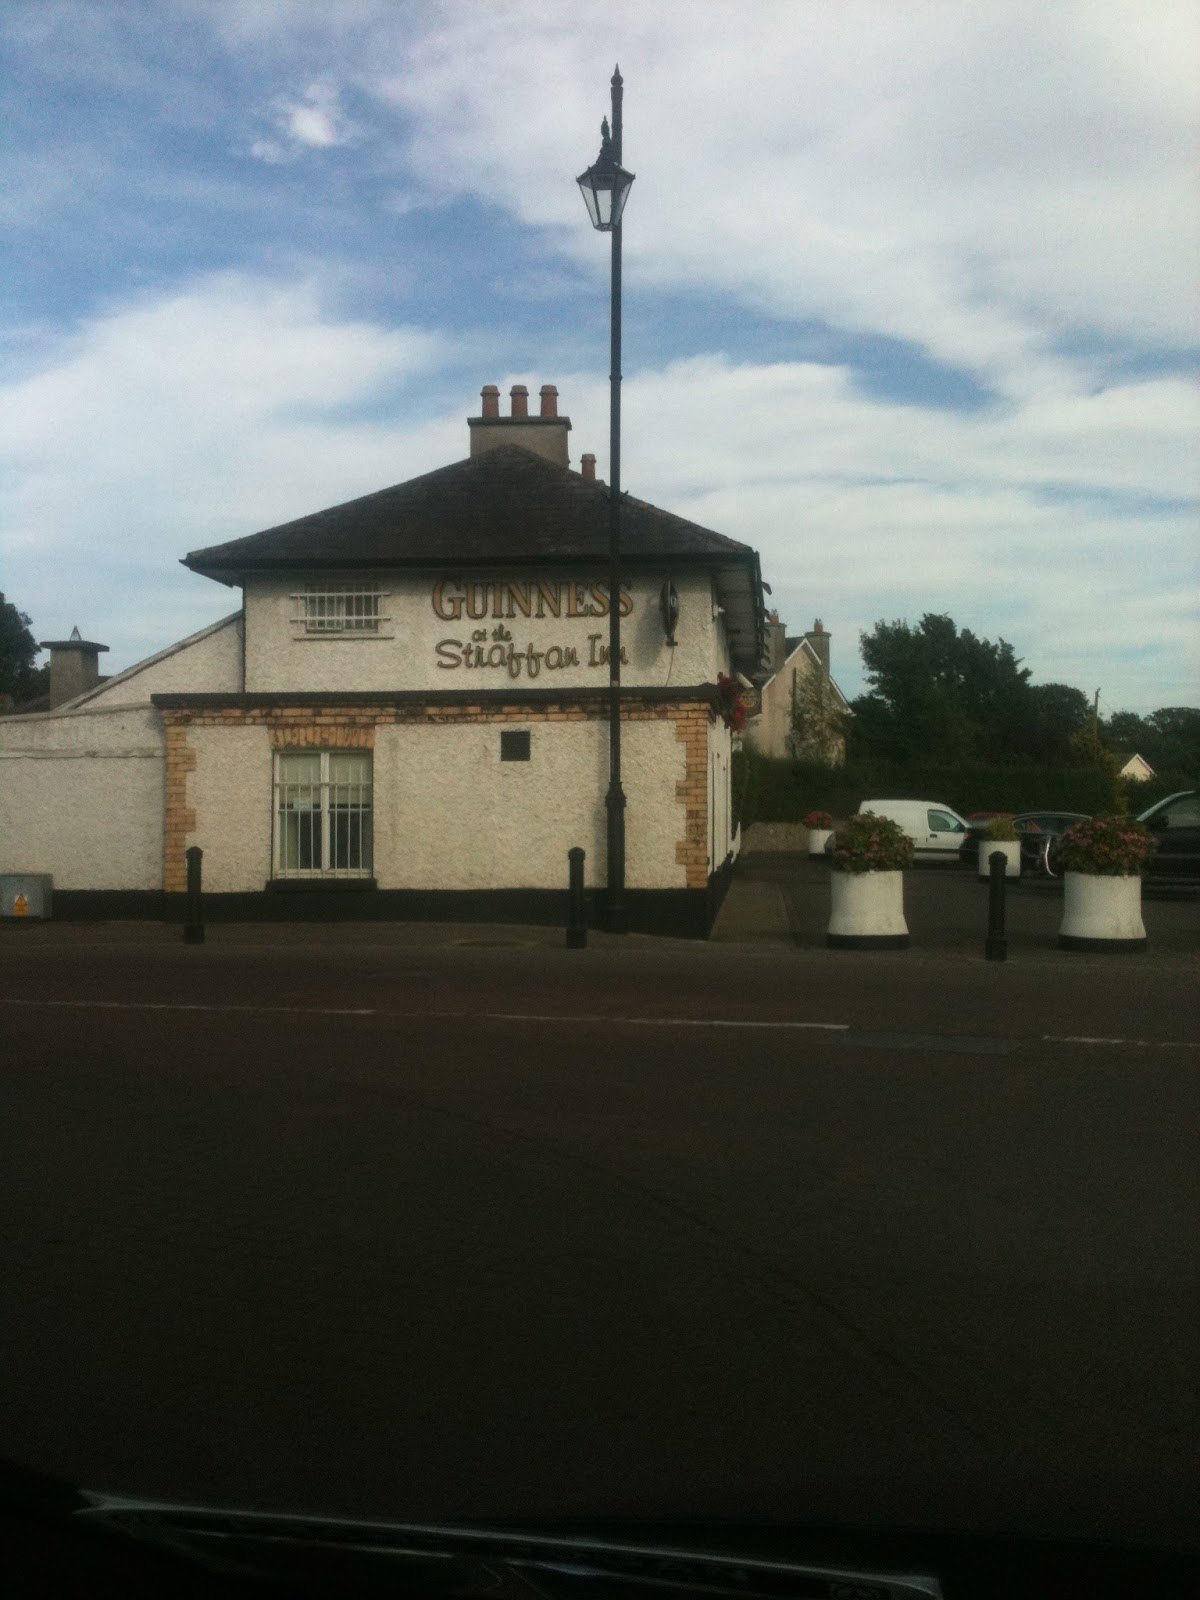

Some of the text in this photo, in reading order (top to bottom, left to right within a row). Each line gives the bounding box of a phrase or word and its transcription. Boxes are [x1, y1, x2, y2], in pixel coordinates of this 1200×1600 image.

[433, 580, 634, 620] GUINNESS
[471, 623, 512, 641] at the
[435, 638, 579, 677] Straffan
